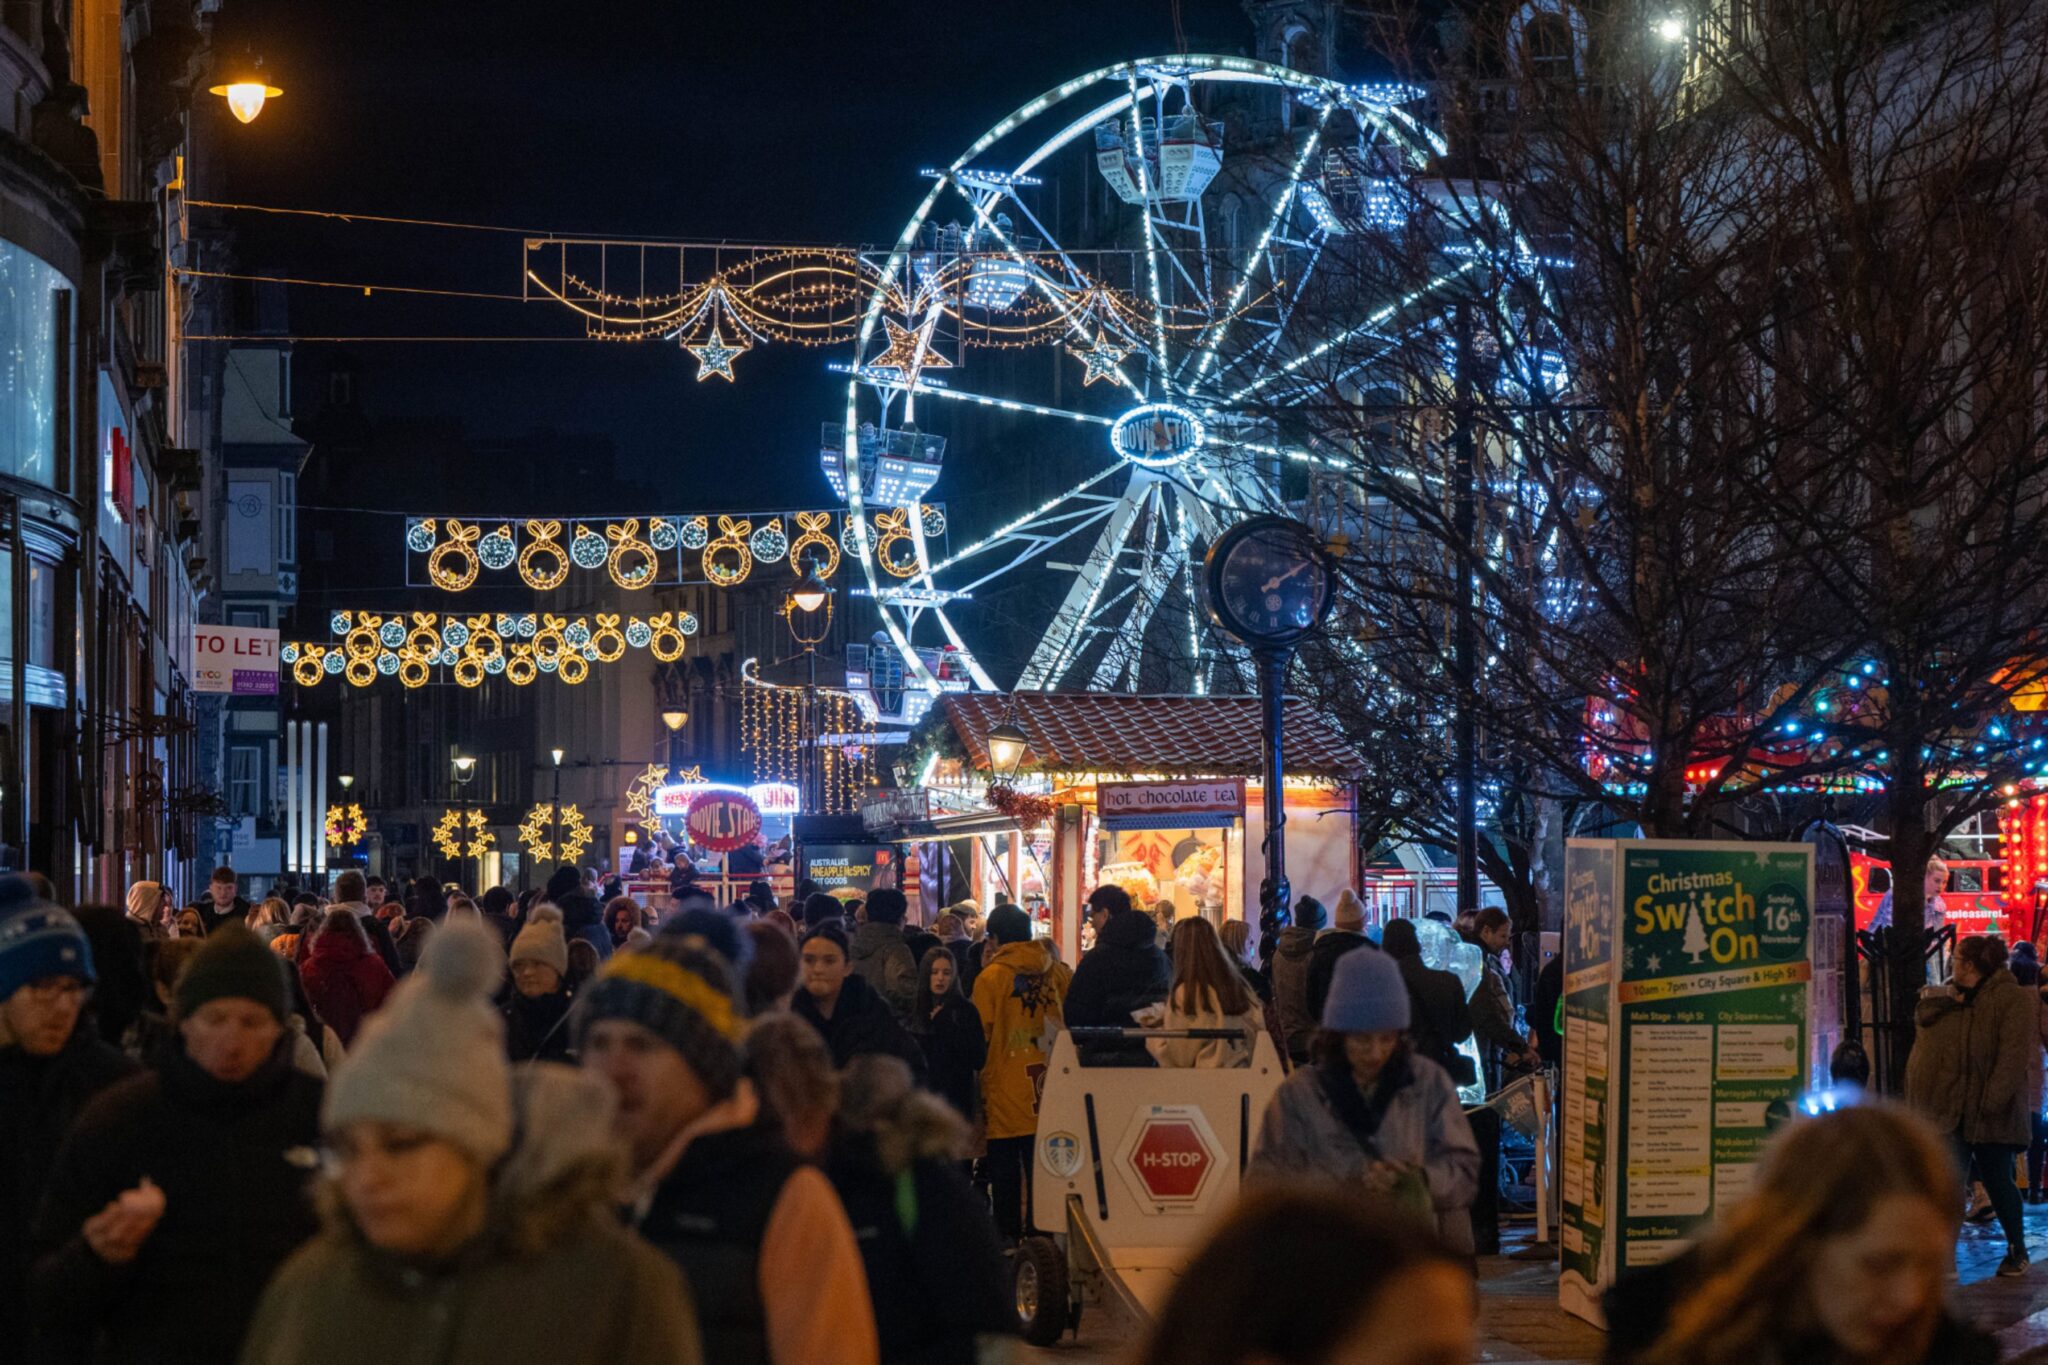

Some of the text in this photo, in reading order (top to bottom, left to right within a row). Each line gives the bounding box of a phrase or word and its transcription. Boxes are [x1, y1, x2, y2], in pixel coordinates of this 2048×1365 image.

[195, 635, 276, 656] TO LET
[1106, 789, 1236, 805] hot chocolate tea
[690, 802, 757, 838] MOVIE STAR
[810, 858, 849, 867] AUSTRALIA'S
[810, 865, 871, 877] PINEAPPLE McSPICY
[1647, 871, 1733, 894] Christmas
[1767, 894, 1795, 906] Sunday
[1763, 907, 1801, 931] 16th
[1710, 927, 1758, 963] On
[1760, 935, 1801, 944] November
[1632, 985, 1660, 995] 10am
[1667, 982, 1688, 993] 7pm
[1697, 978, 1716, 990] City
[1719, 974, 1751, 988] Square
[1753, 973, 1760, 982] &
[1763, 969, 1784, 982] High
[1787, 968, 1797, 978] St
[1143, 1152, 1201, 1167] H-STOP
[1626, 1226, 1678, 1237] Street Traders
